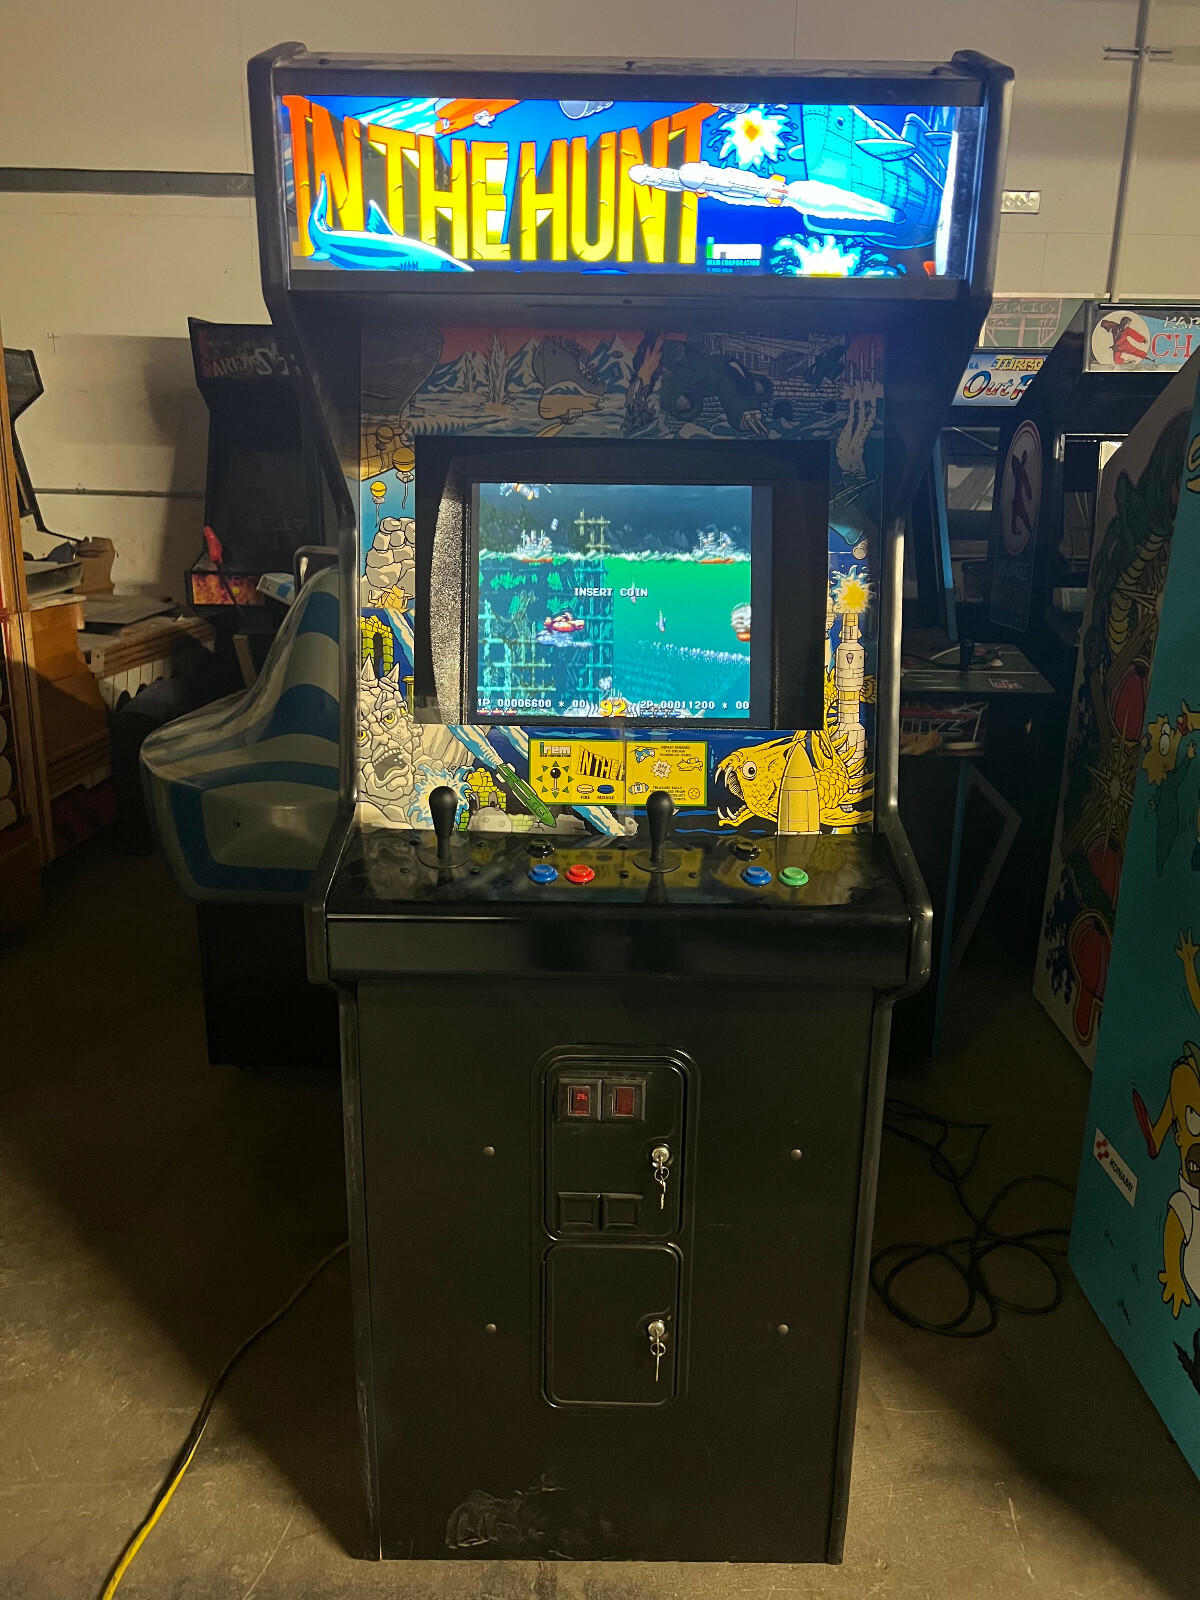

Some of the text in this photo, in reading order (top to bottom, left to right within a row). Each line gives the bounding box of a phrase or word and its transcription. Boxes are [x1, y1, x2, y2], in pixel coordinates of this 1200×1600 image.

[282, 95, 720, 264] IN THE HUNT
[706, 236, 762, 260] ir
[721, 259, 761, 267] CORPORATION
[993, 355, 1045, 371] TURBO
[573, 587, 648, 597] INSERT COIN
[477, 699, 491, 708] 1P
[497, 699, 552, 708] 00006600
[600, 700, 628, 718] 92
[640, 700, 750, 710] 2P 00011200 00
[539, 742, 572, 754] irem
[575, 745, 594, 776] IN
[593, 753, 620, 781] THE
[1109, 1158, 1134, 1193] KONAMI
